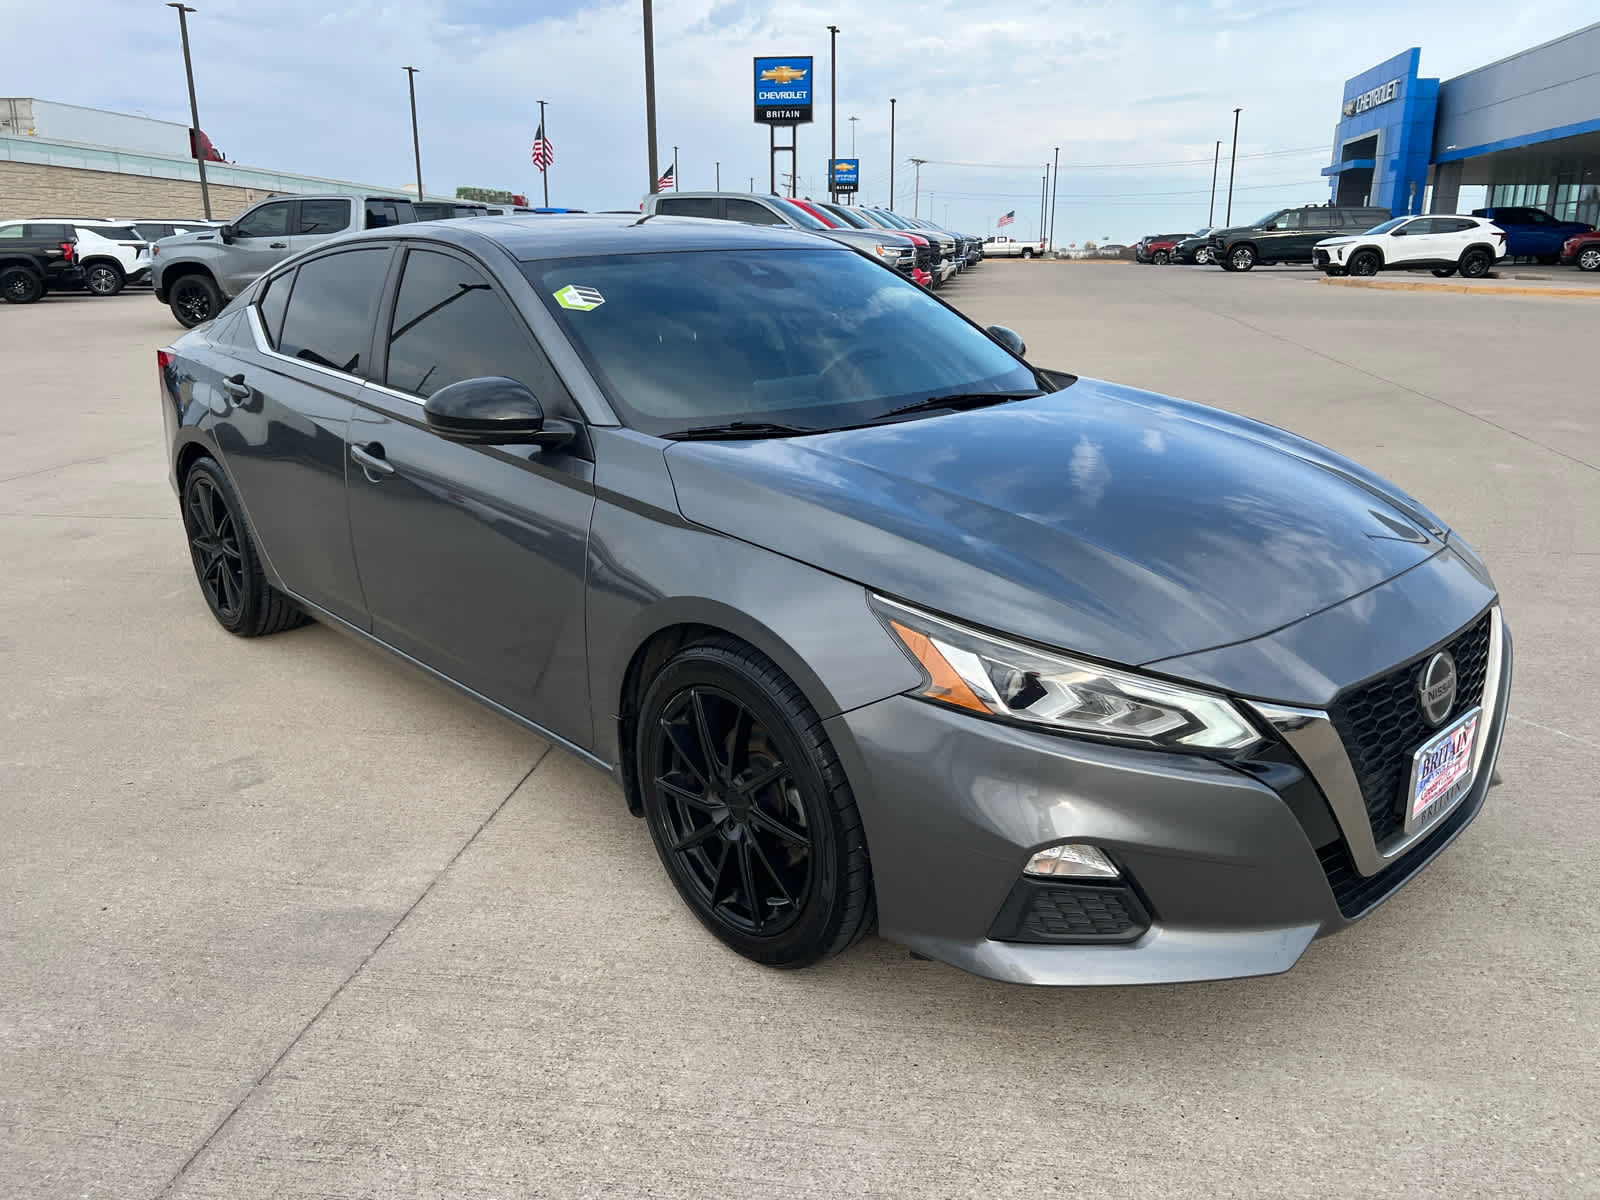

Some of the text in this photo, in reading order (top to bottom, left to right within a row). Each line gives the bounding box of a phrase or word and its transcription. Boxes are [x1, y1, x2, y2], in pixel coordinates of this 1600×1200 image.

[758, 90, 808, 100] CHEVROLET
[1356, 79, 1401, 114] CHEVROLET
[766, 110, 800, 118] BRITAIN
[1421, 731, 1469, 779] BRITAIN
[1421, 782, 1461, 824] BRITAIN
